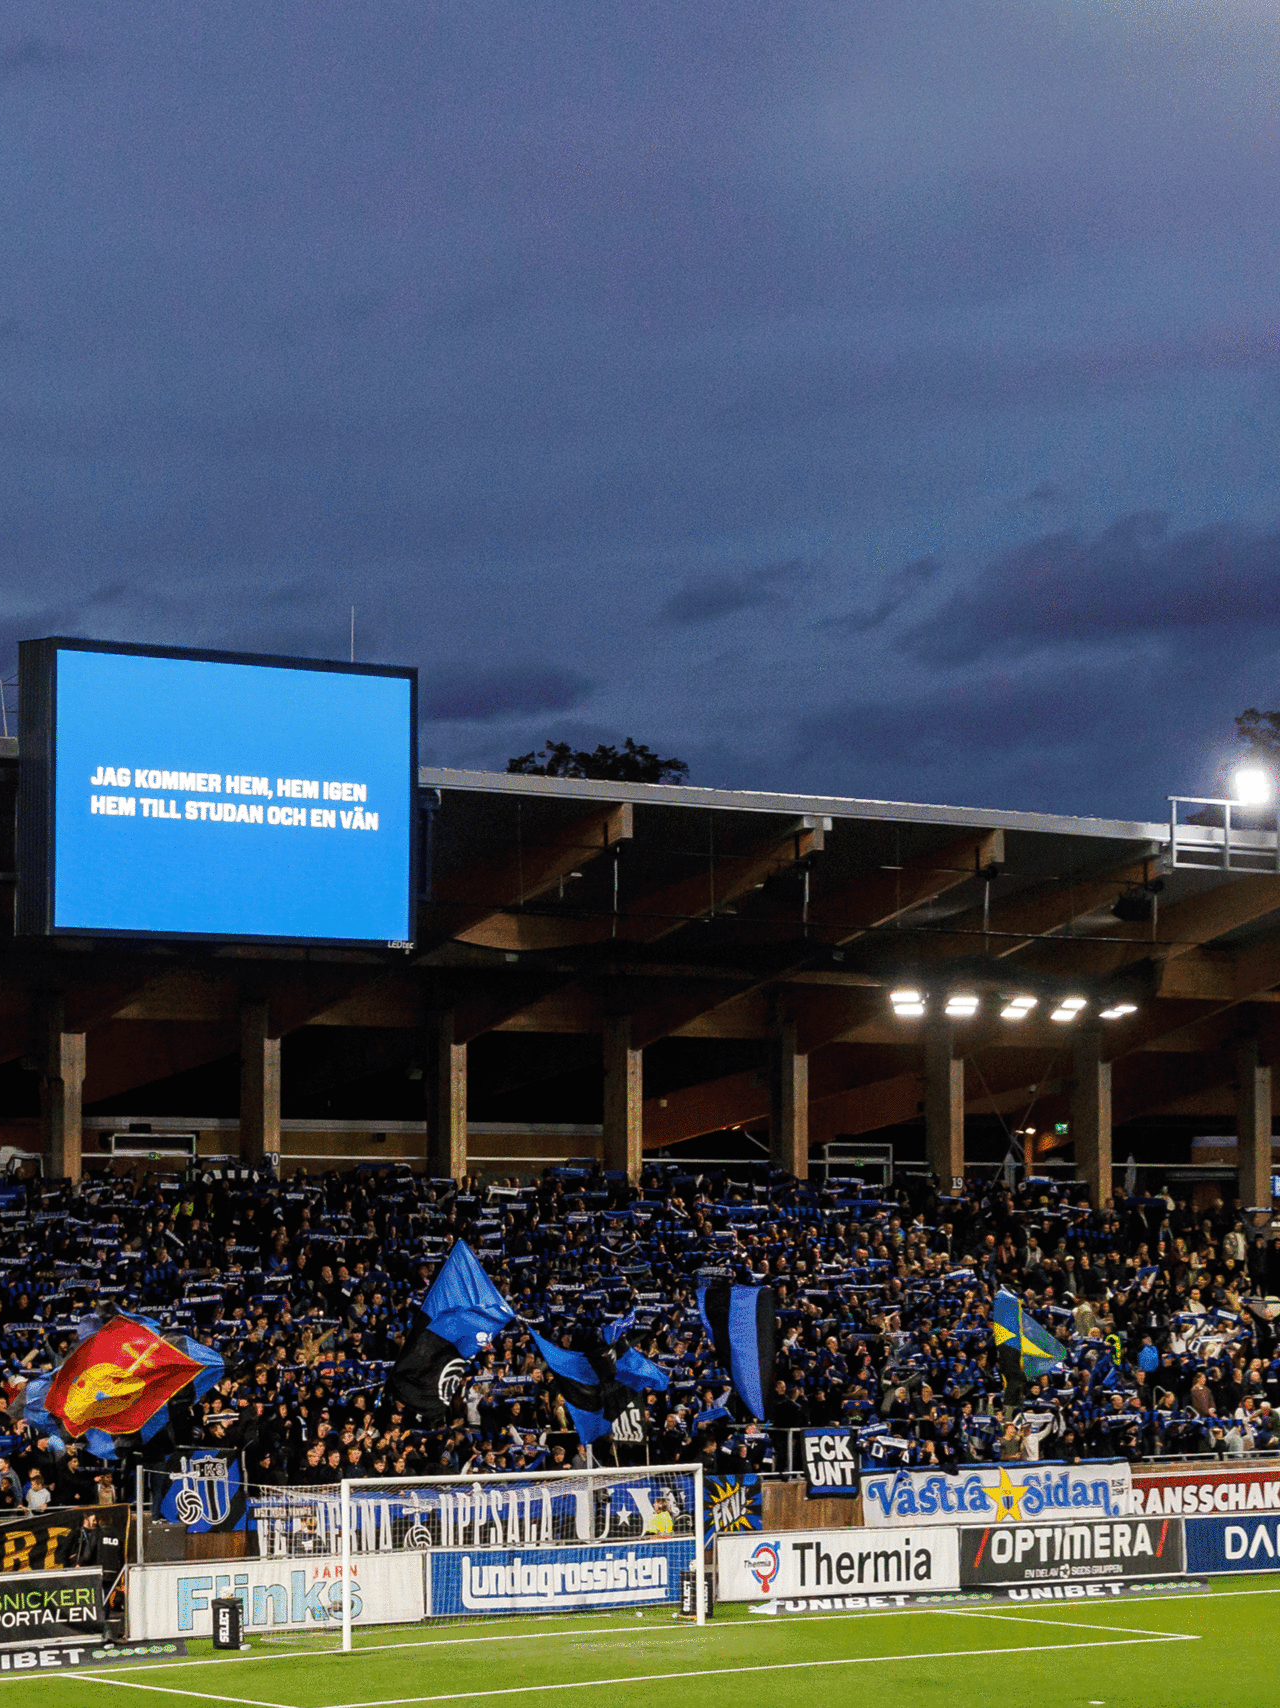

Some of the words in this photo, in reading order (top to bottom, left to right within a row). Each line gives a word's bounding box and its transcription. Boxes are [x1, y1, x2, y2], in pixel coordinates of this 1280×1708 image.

[90, 766, 131, 787] JAG
[134, 768, 221, 793] KOMMER
[225, 775, 273, 799] HEM,
[276, 778, 320, 799] HEM
[322, 781, 367, 802] IGEN
[90, 795, 135, 816] HEM
[139, 798, 181, 819] TILL
[184, 801, 263, 824] STUDAN
[266, 806, 307, 826] OCH
[310, 808, 336, 829] EN
[339, 806, 380, 831] VÄN
[952, 1177, 963, 1189] 19
[804, 1436, 851, 1461] FCK
[807, 1461, 855, 1486] UNT
[867, 1473, 993, 1517] Västra
[1023, 1471, 1114, 1516] Sidan
[991, 1523, 1154, 1564] OPTIMERA
[313, 1563, 357, 1579] JÄRN
[744, 1559, 771, 1568] Thermia
[792, 1538, 932, 1587] Thermia
[462, 1553, 669, 1609] Lundagrossisten
[1008, 1583, 1124, 1601] UNIBET
[219, 1608, 230, 1643] SELECT
